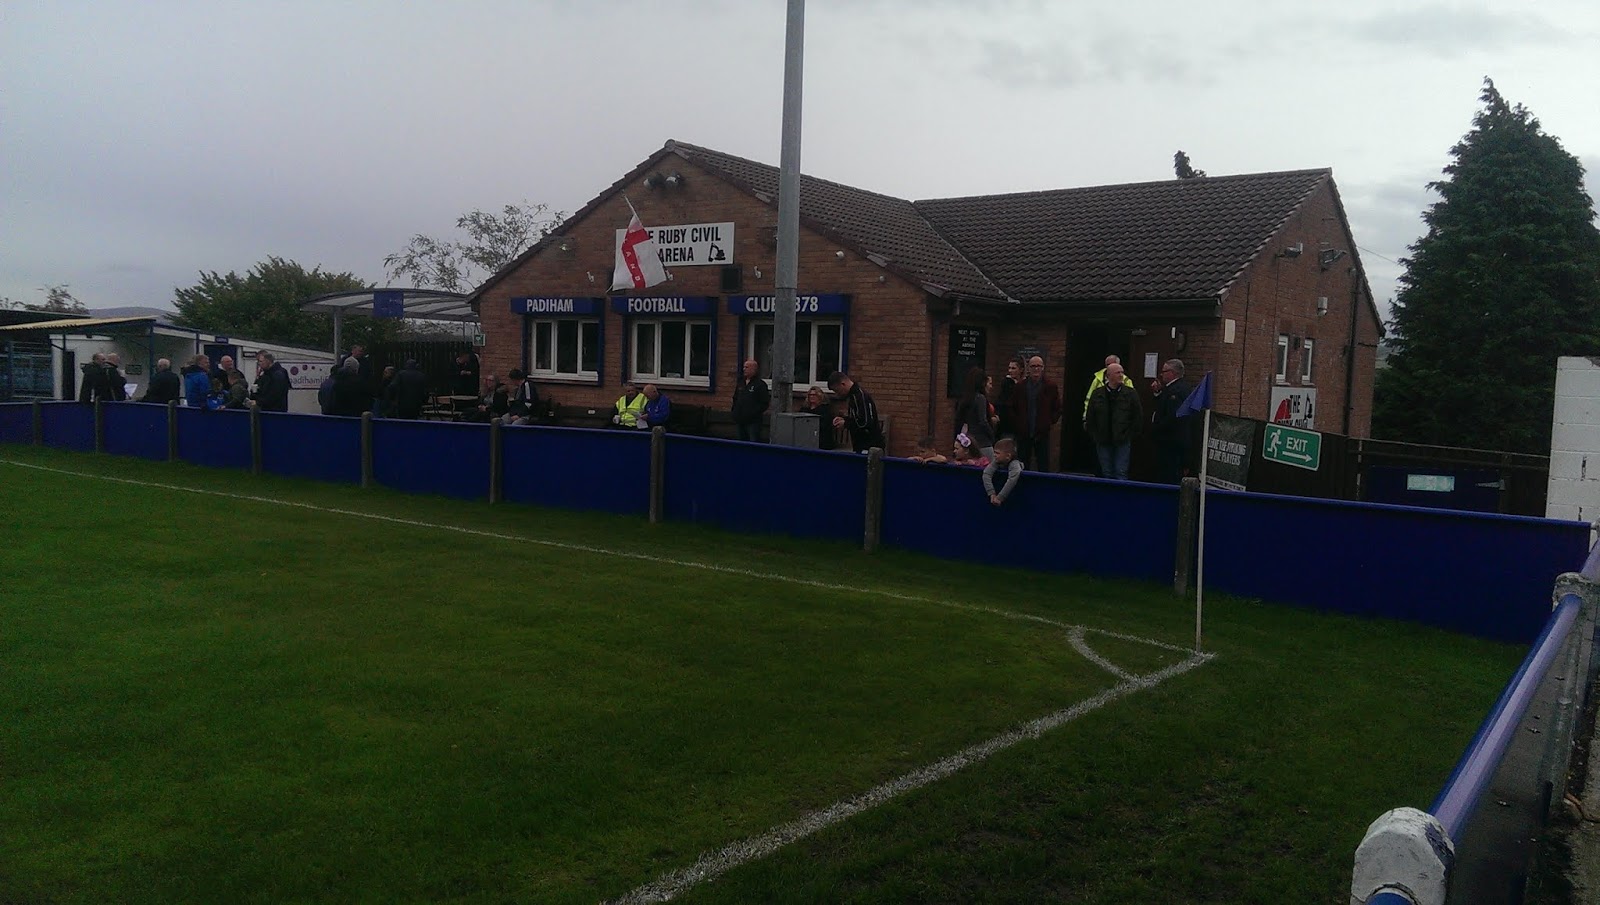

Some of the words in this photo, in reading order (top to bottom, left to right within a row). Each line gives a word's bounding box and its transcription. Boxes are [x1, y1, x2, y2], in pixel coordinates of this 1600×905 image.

[658, 228, 687, 244] RUBY
[691, 226, 721, 243] CIVIL
[658, 247, 694, 262] ARENA
[526, 298, 574, 313] PADIHAM
[627, 298, 686, 313] FOOTBALL
[1290, 395, 1301, 413] THE
[1286, 436, 1308, 452] EXIT
